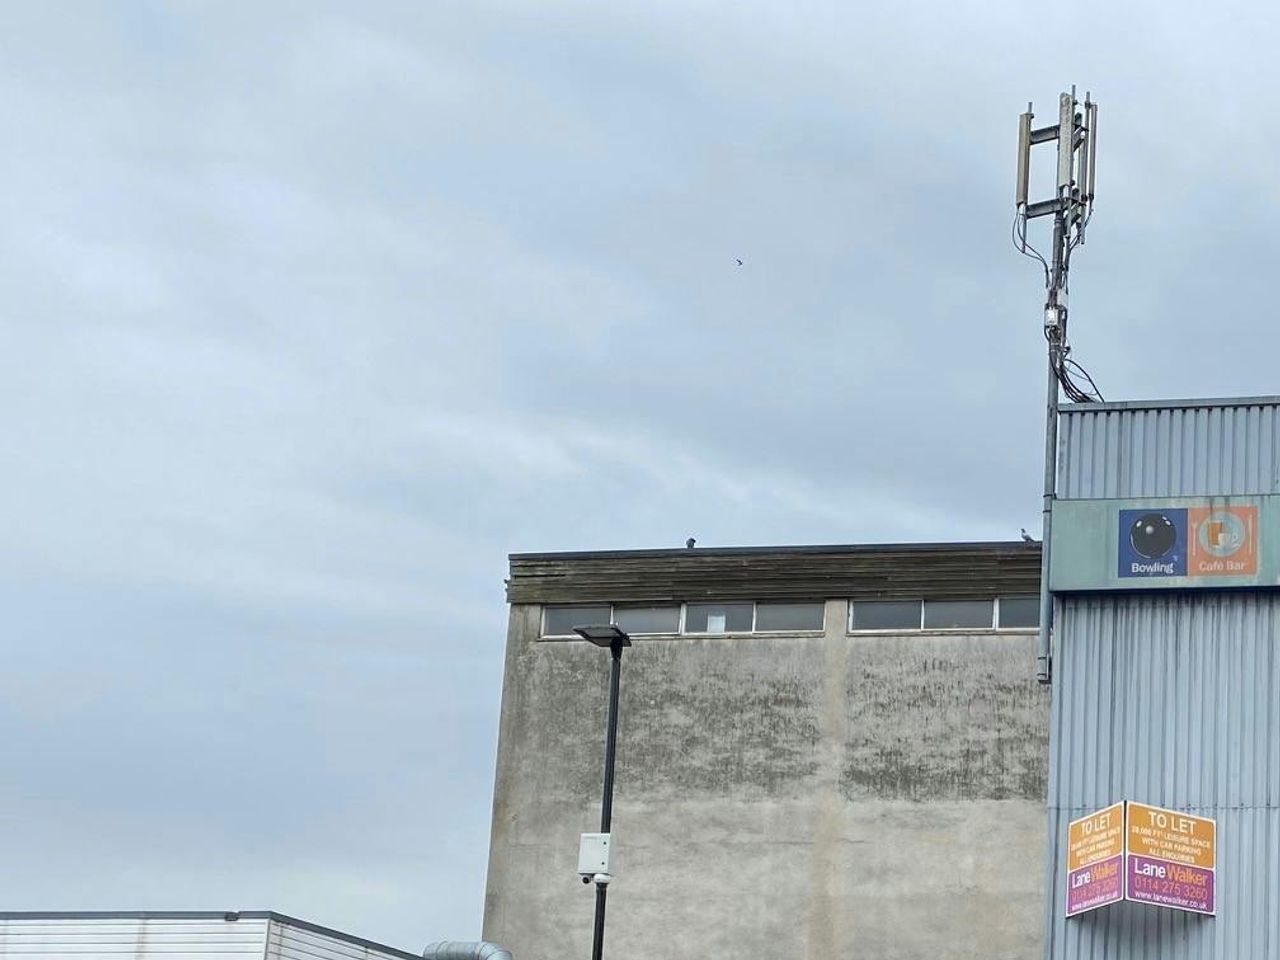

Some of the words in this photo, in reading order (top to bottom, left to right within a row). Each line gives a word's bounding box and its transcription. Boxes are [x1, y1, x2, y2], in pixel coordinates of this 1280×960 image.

[1131, 562, 1175, 574] Bowling
[1199, 560, 1225, 571] Café
[1226, 560, 1246, 571] Bar
[1081, 821, 1093, 836] TO
[1094, 813, 1111, 831] LET
[1148, 811, 1167, 828] TO
[1171, 813, 1197, 835] LET
[1072, 870, 1091, 889] Lane
[1134, 858, 1166, 879] Lane
[1166, 864, 1208, 886] Walker
[1134, 876, 1159, 891] 0114
